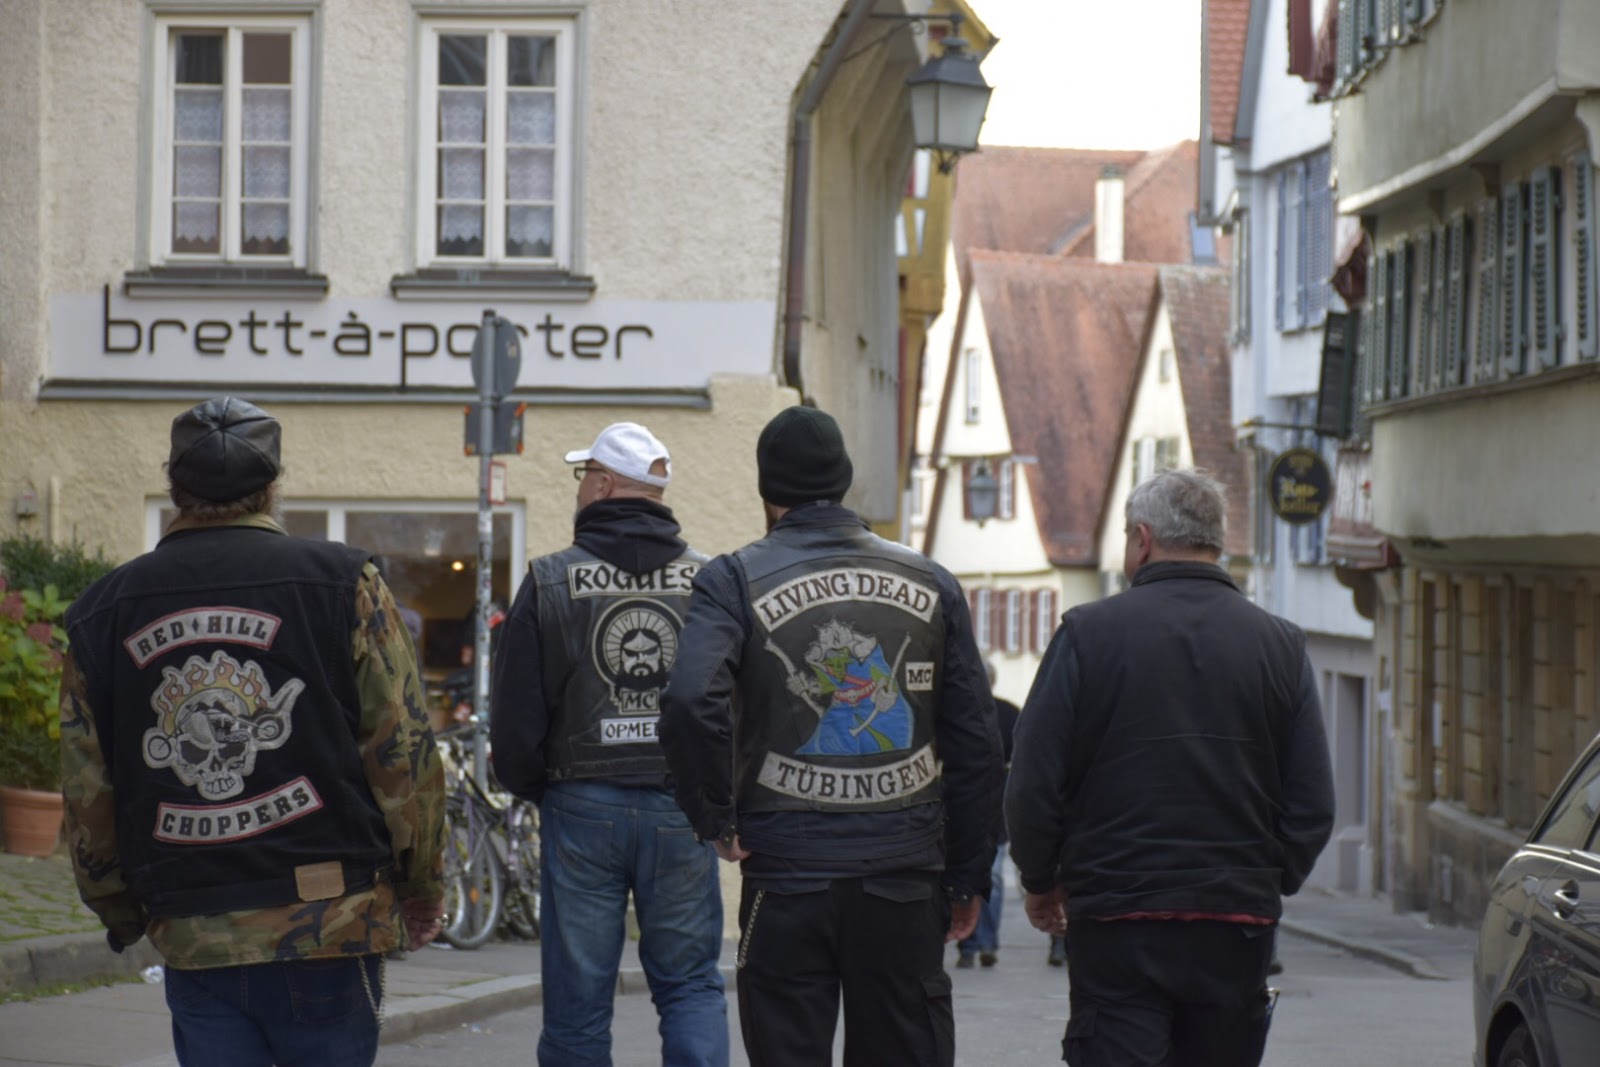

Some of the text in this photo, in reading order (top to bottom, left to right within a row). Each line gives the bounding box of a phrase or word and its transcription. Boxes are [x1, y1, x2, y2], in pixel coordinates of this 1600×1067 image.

[574, 563, 695, 592] ROGUES
[759, 573, 930, 625] LIVING DEAD
[137, 615, 269, 658] RED HILL
[907, 668, 931, 684] MC
[624, 693, 656, 709] MC
[777, 755, 930, 799] TÜBINGEN
[162, 787, 310, 837] CHOPPERS
